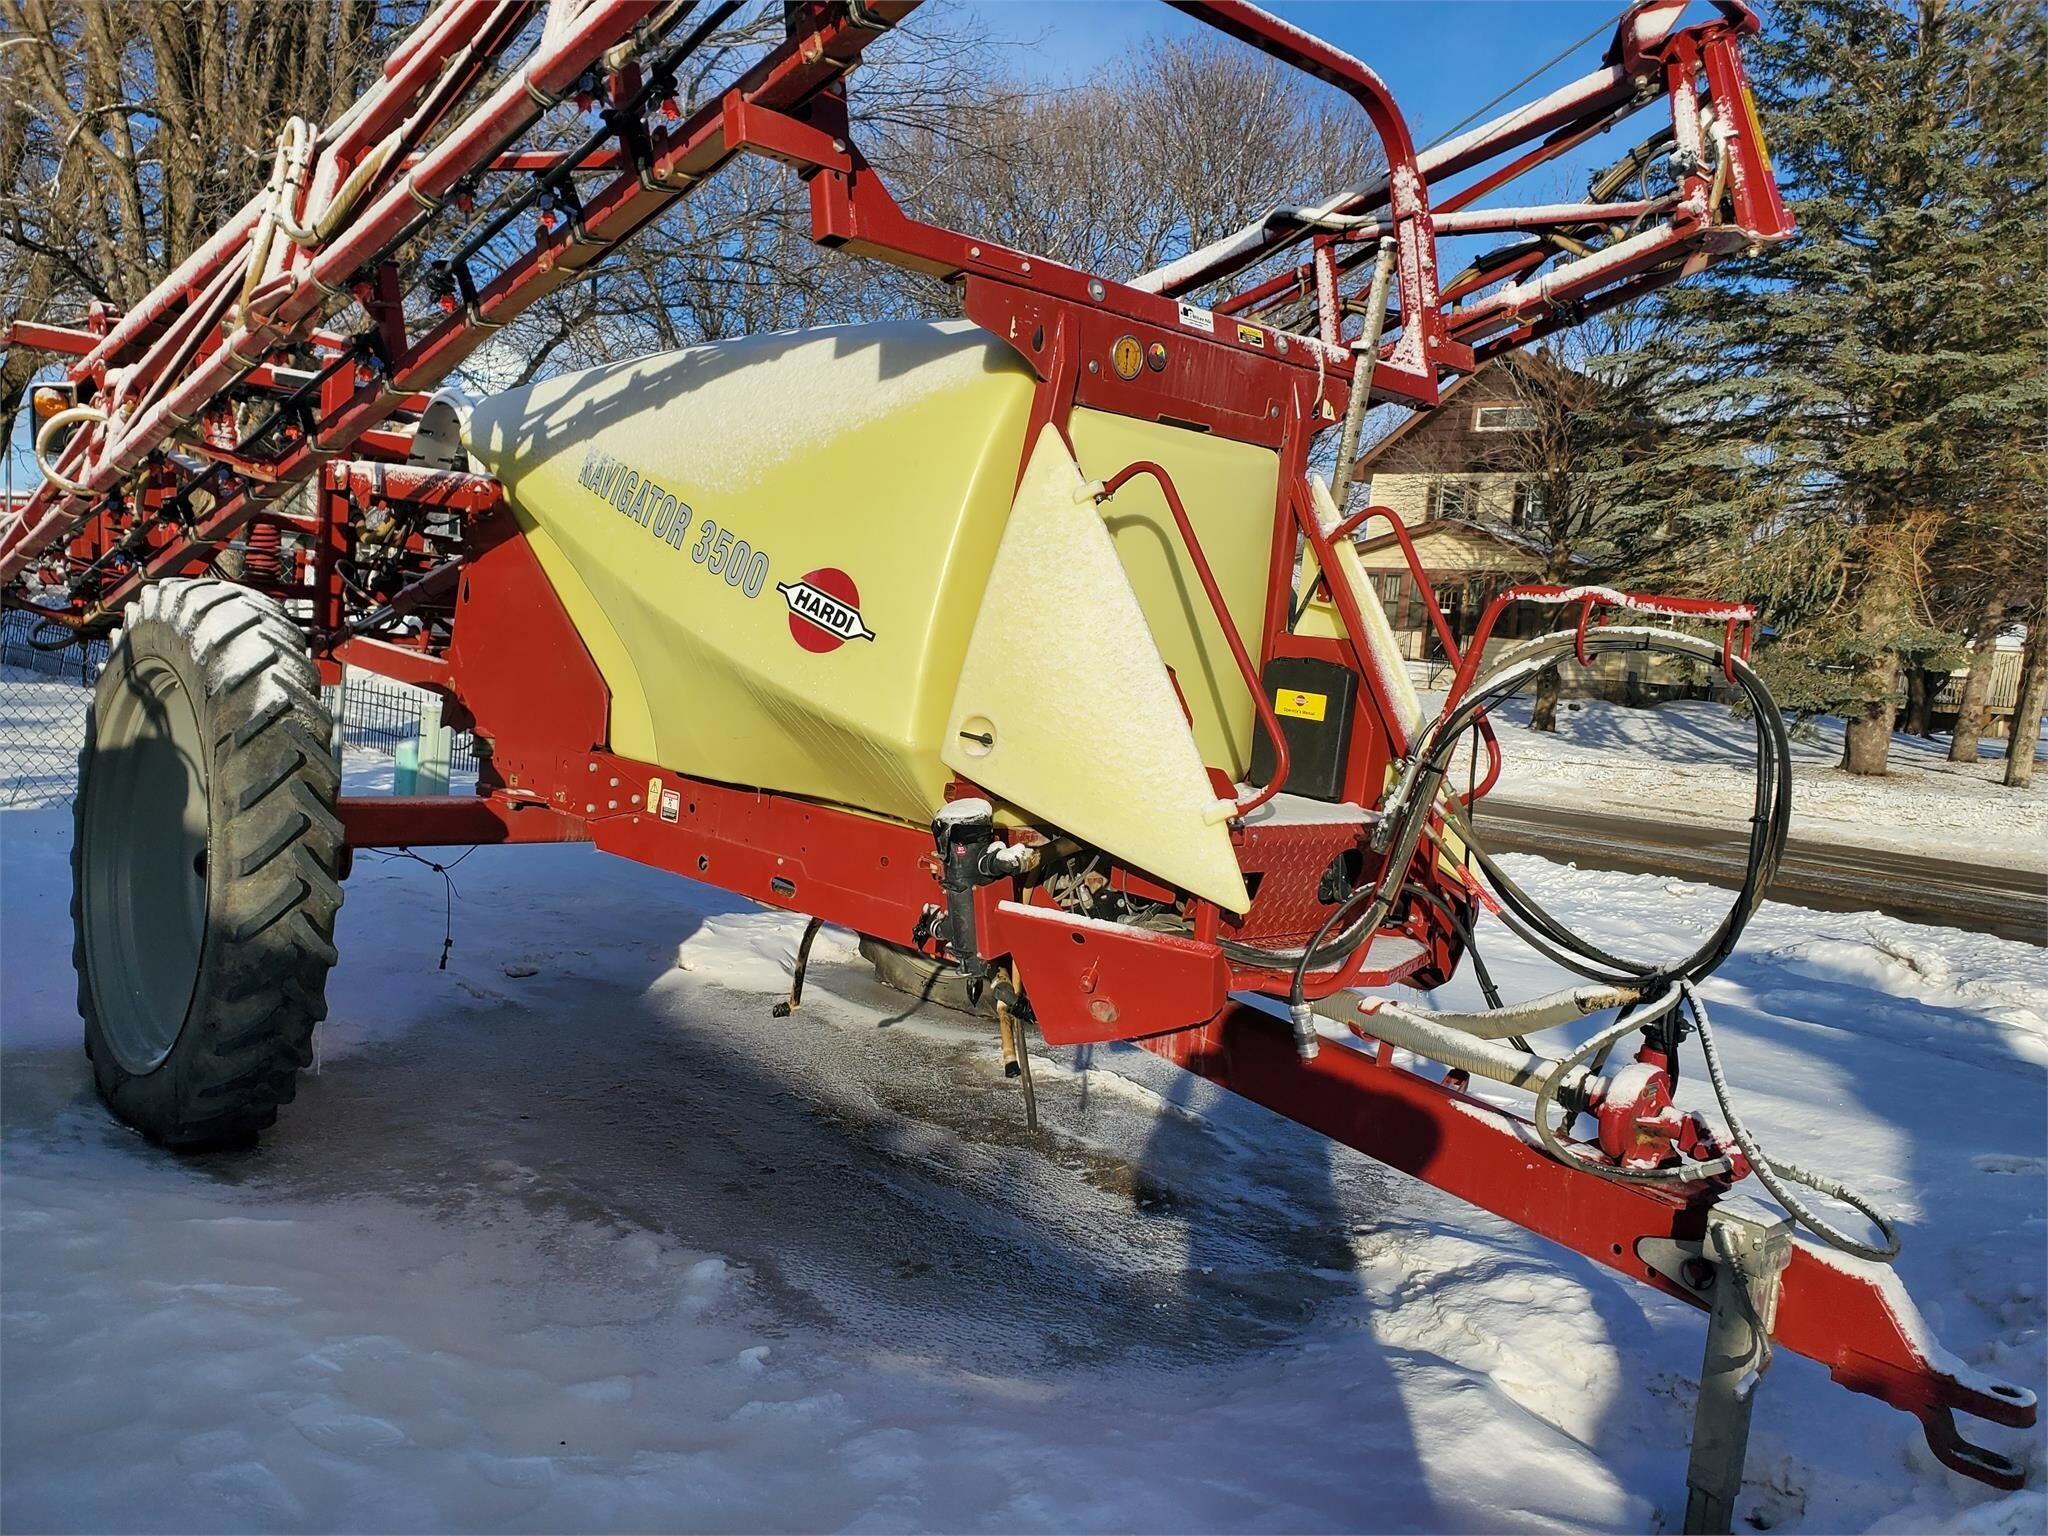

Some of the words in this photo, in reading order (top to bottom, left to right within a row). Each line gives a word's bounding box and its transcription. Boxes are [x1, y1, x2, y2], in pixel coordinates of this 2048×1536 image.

[578, 450, 693, 550] NAVIGATOR
[691, 520, 770, 599] 3500
[794, 588, 856, 634] HARDI
